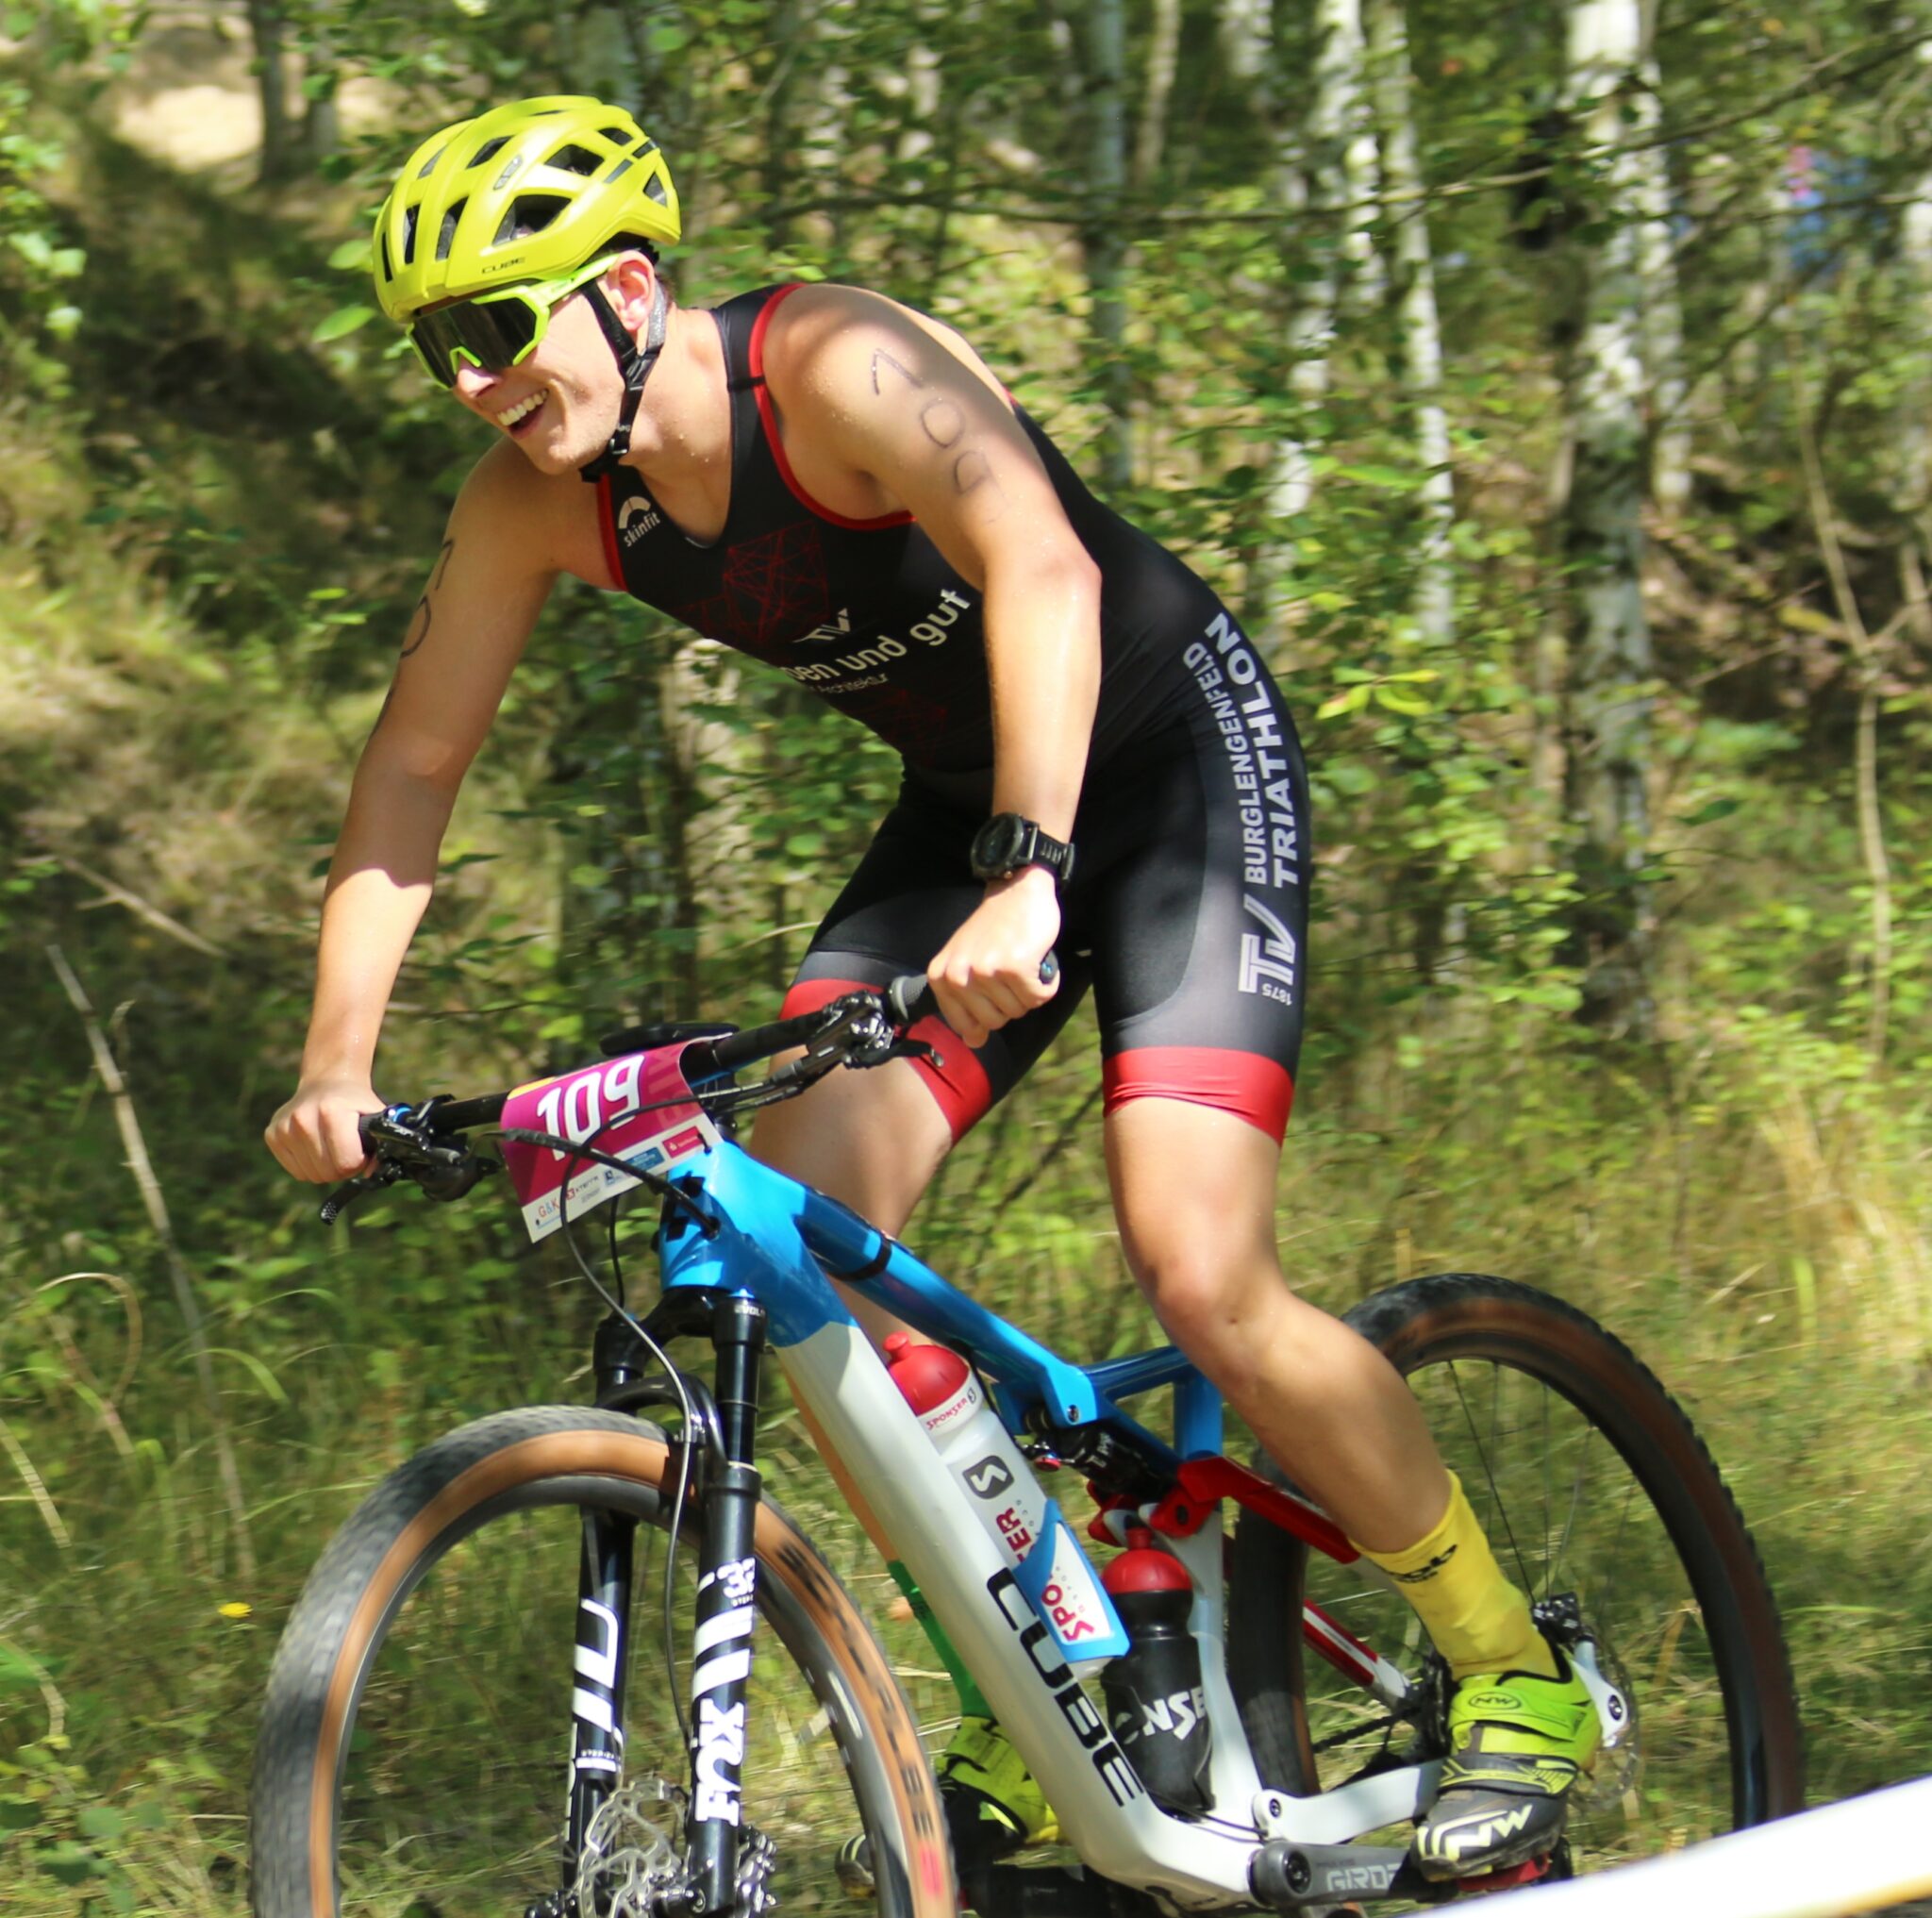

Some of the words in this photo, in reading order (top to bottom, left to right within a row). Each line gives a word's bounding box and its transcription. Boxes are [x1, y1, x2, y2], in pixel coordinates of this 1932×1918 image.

[481, 256, 525, 274] CUBE
[624, 512, 660, 547] skinfit
[835, 635, 908, 671] und
[909, 589, 971, 646] gut
[1204, 612, 1299, 888] TRIATHLON
[537, 1054, 645, 1161] 109
[926, 1397, 968, 1430] SPONSER
[987, 1567, 1145, 1808] CUBE
[694, 1698, 745, 1826] FOX
